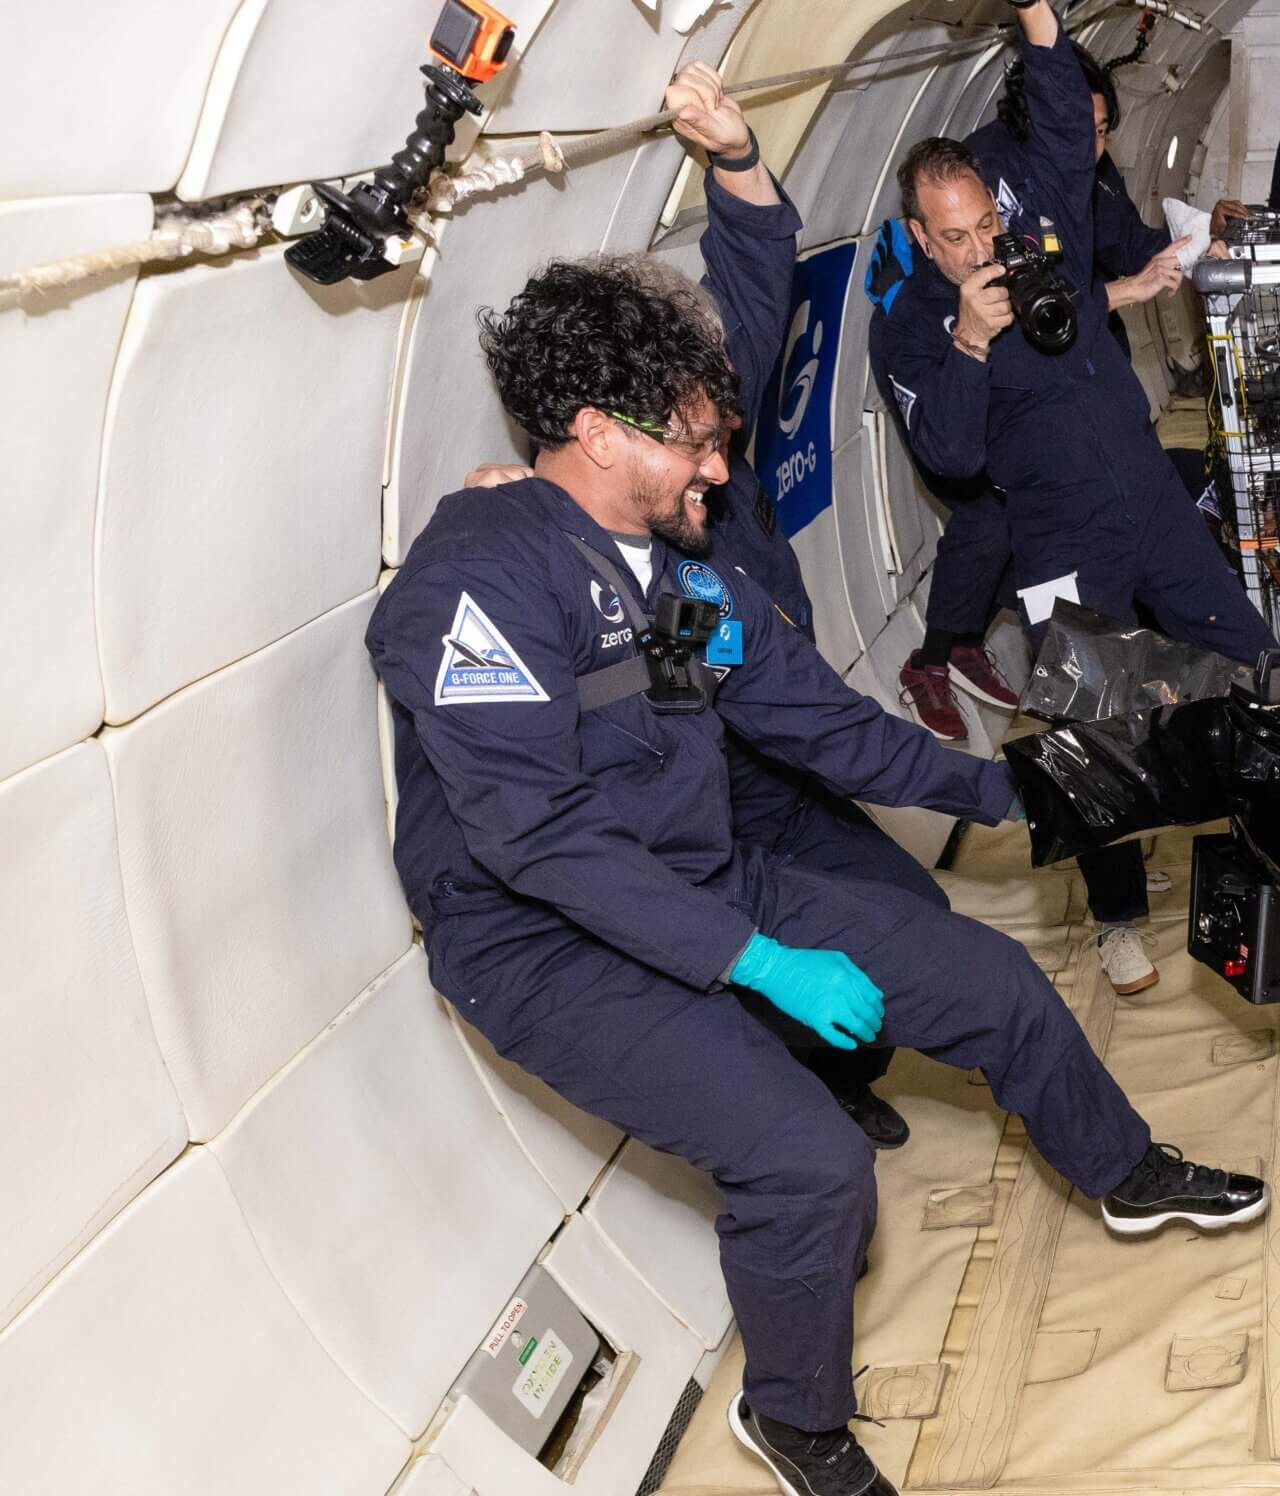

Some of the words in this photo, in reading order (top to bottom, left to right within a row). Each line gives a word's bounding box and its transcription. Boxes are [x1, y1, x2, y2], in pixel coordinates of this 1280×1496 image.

[776, 441, 816, 502] zero-G
[451, 672, 497, 685] G-FORCE
[500, 672, 521, 684] ONE
[488, 1333, 505, 1351] PULL
[500, 1321, 511, 1332] TO
[508, 1302, 524, 1322] OPEN
